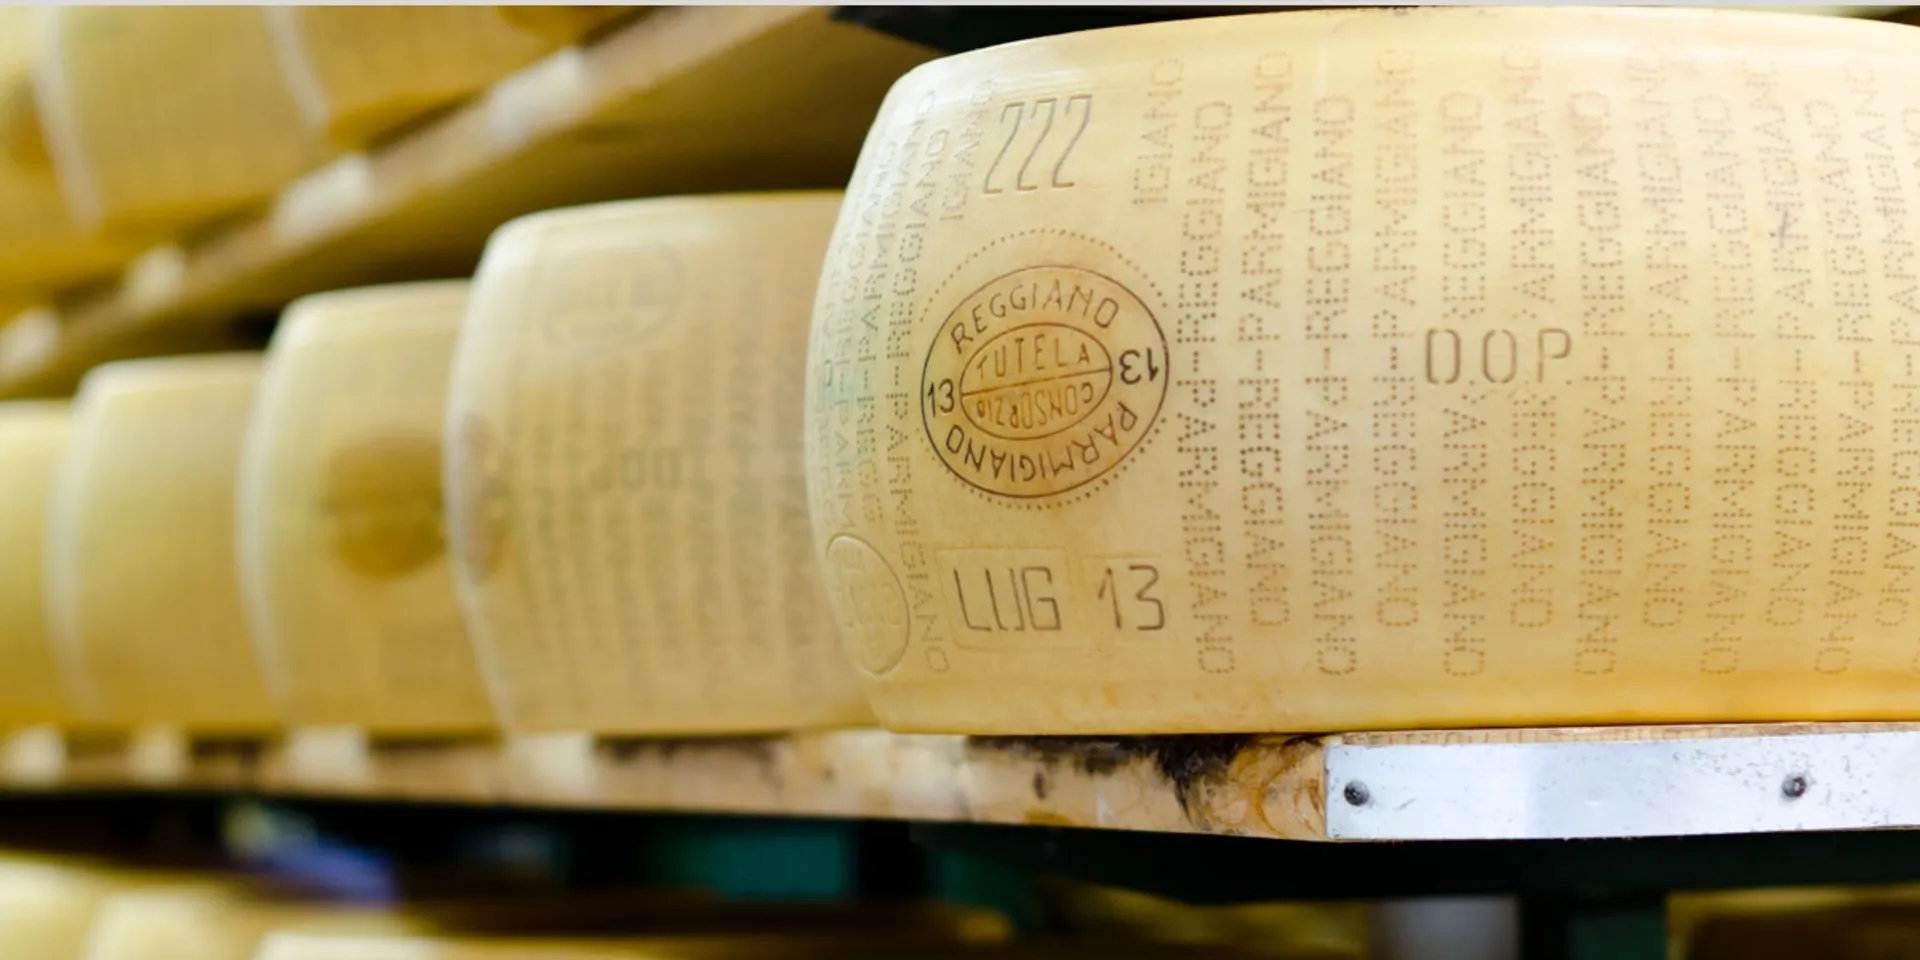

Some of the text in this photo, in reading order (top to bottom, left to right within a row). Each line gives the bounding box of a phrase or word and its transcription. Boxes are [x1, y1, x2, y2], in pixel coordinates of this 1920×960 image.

[1499, 46, 1556, 320] ARMIGIANO
[950, 278, 1120, 355] REGGIANO
[976, 333, 1091, 380] TUTELA
[927, 378, 956, 418] 13
[976, 382, 1095, 430] CONSORZIO
[945, 401, 1139, 483] PARMIGIANO
[952, 564, 1062, 631] LUG
[1098, 563, 1166, 631] 13
